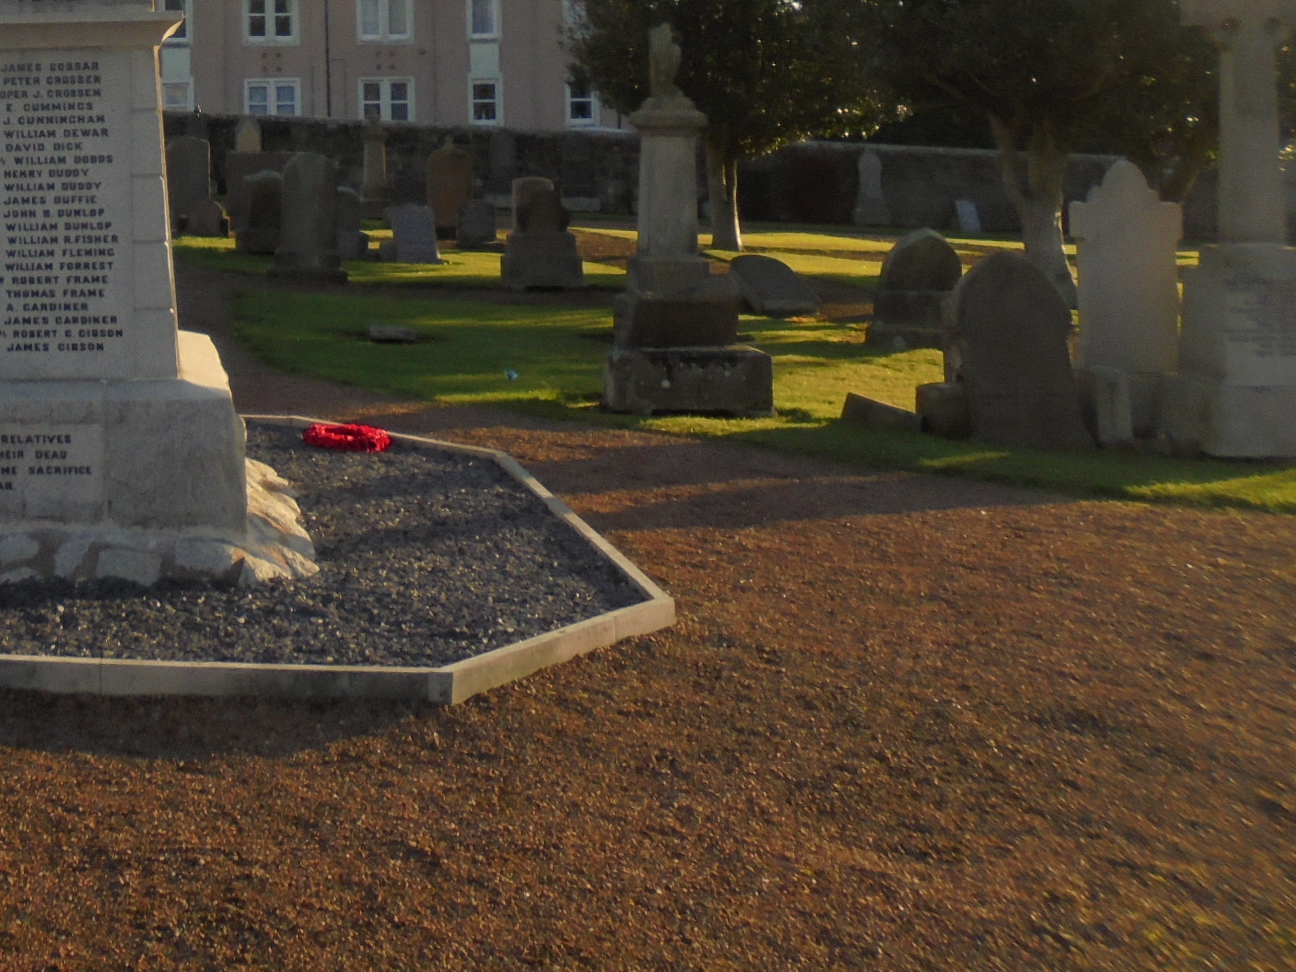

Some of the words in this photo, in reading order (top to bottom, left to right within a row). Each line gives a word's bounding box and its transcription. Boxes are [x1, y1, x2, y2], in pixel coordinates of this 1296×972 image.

[1, 63, 42, 73] JAMES
[49, 61, 99, 71] COSSAR
[3, 76, 40, 86] PETER
[45, 75, 102, 85] CROSSEN
[47, 88, 102, 98] CROSSEN
[23, 102, 94, 112] CUMMINGS
[18, 115, 106, 125] CUNNINGHAM
[4, 129, 56, 139] WILLIAM
[63, 128, 109, 138] DEWAR
[5, 143, 45, 152] DAVID
[53, 142, 83, 151] DICK
[14, 156, 66, 165] WILLIAM
[73, 155, 113, 164] DODDS
[4, 169, 43, 179] HENRY
[48, 168, 89, 178] DUDDY
[5, 182, 55, 192] WILLIAM
[61, 182, 102, 191] DUDDY
[4, 196, 46, 205] JAMES
[53, 195, 97, 205] DUFFIE
[3, 209, 36, 218] JOHN
[57, 208, 105, 218] DUNLOP
[5, 222, 58, 231] WILLIAM
[64, 221, 112, 231] DUNLOP
[7, 235, 58, 245] WILLIAM
[74, 235, 119, 244] FISHER
[5, 249, 54, 258] WILLIAM
[62, 248, 115, 257] FLEMING
[5, 262, 54, 271] WILLIAM
[59, 262, 114, 271] FORREST
[12, 276, 59, 285] ROBERT
[66, 275, 109, 284] FRAME
[6, 289, 55, 298] THOMAS
[62, 289, 106, 298] FRAME
[23, 303, 88, 312] GARDINER
[4, 316, 49, 325] JAMES
[55, 315, 118, 325] GARDINER
[13, 329, 58, 338] ROBERT
[78, 329, 123, 338] GIBSON
[7, 343, 50, 352] JAMES
[57, 343, 104, 352] GIBSON
[1, 434, 72, 444] RELATIVES
[34, 450, 67, 460] DEAD
[28, 466, 92, 475] SACRIFICE
